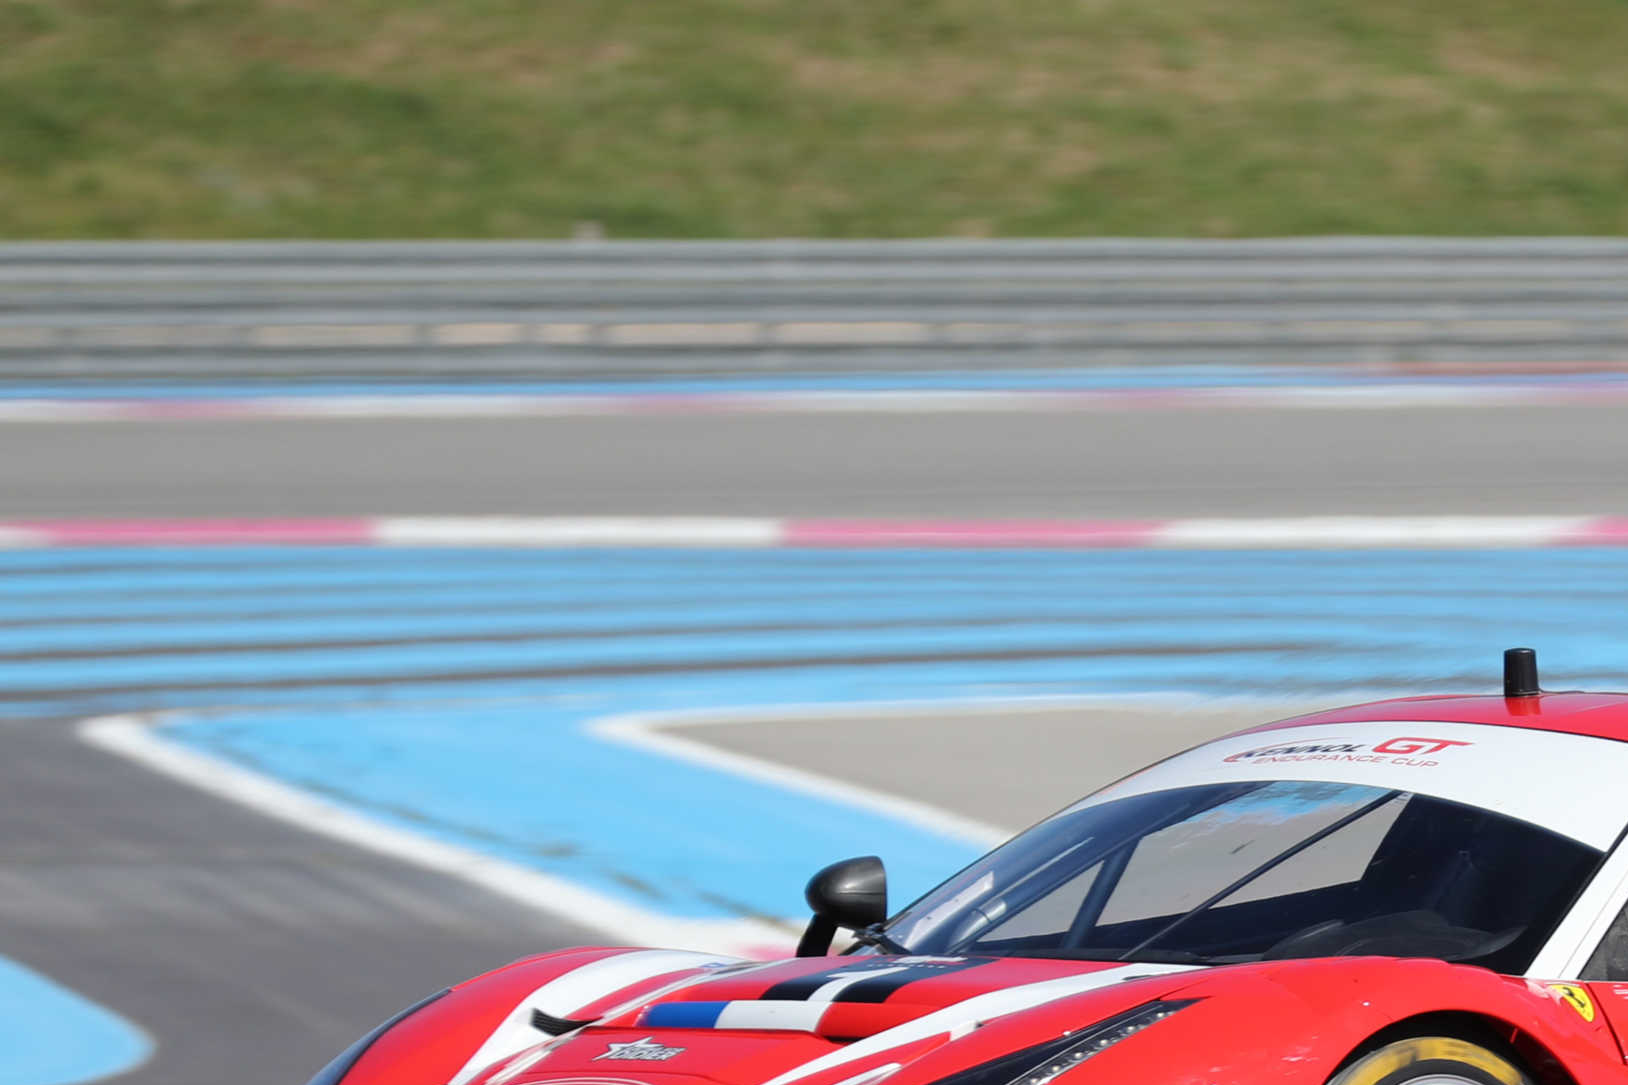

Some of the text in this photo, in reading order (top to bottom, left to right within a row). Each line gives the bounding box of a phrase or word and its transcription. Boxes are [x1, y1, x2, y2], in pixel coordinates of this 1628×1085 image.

[1372, 736, 1476, 755] GT
[1251, 753, 1440, 769] ENDURANCE CUP
